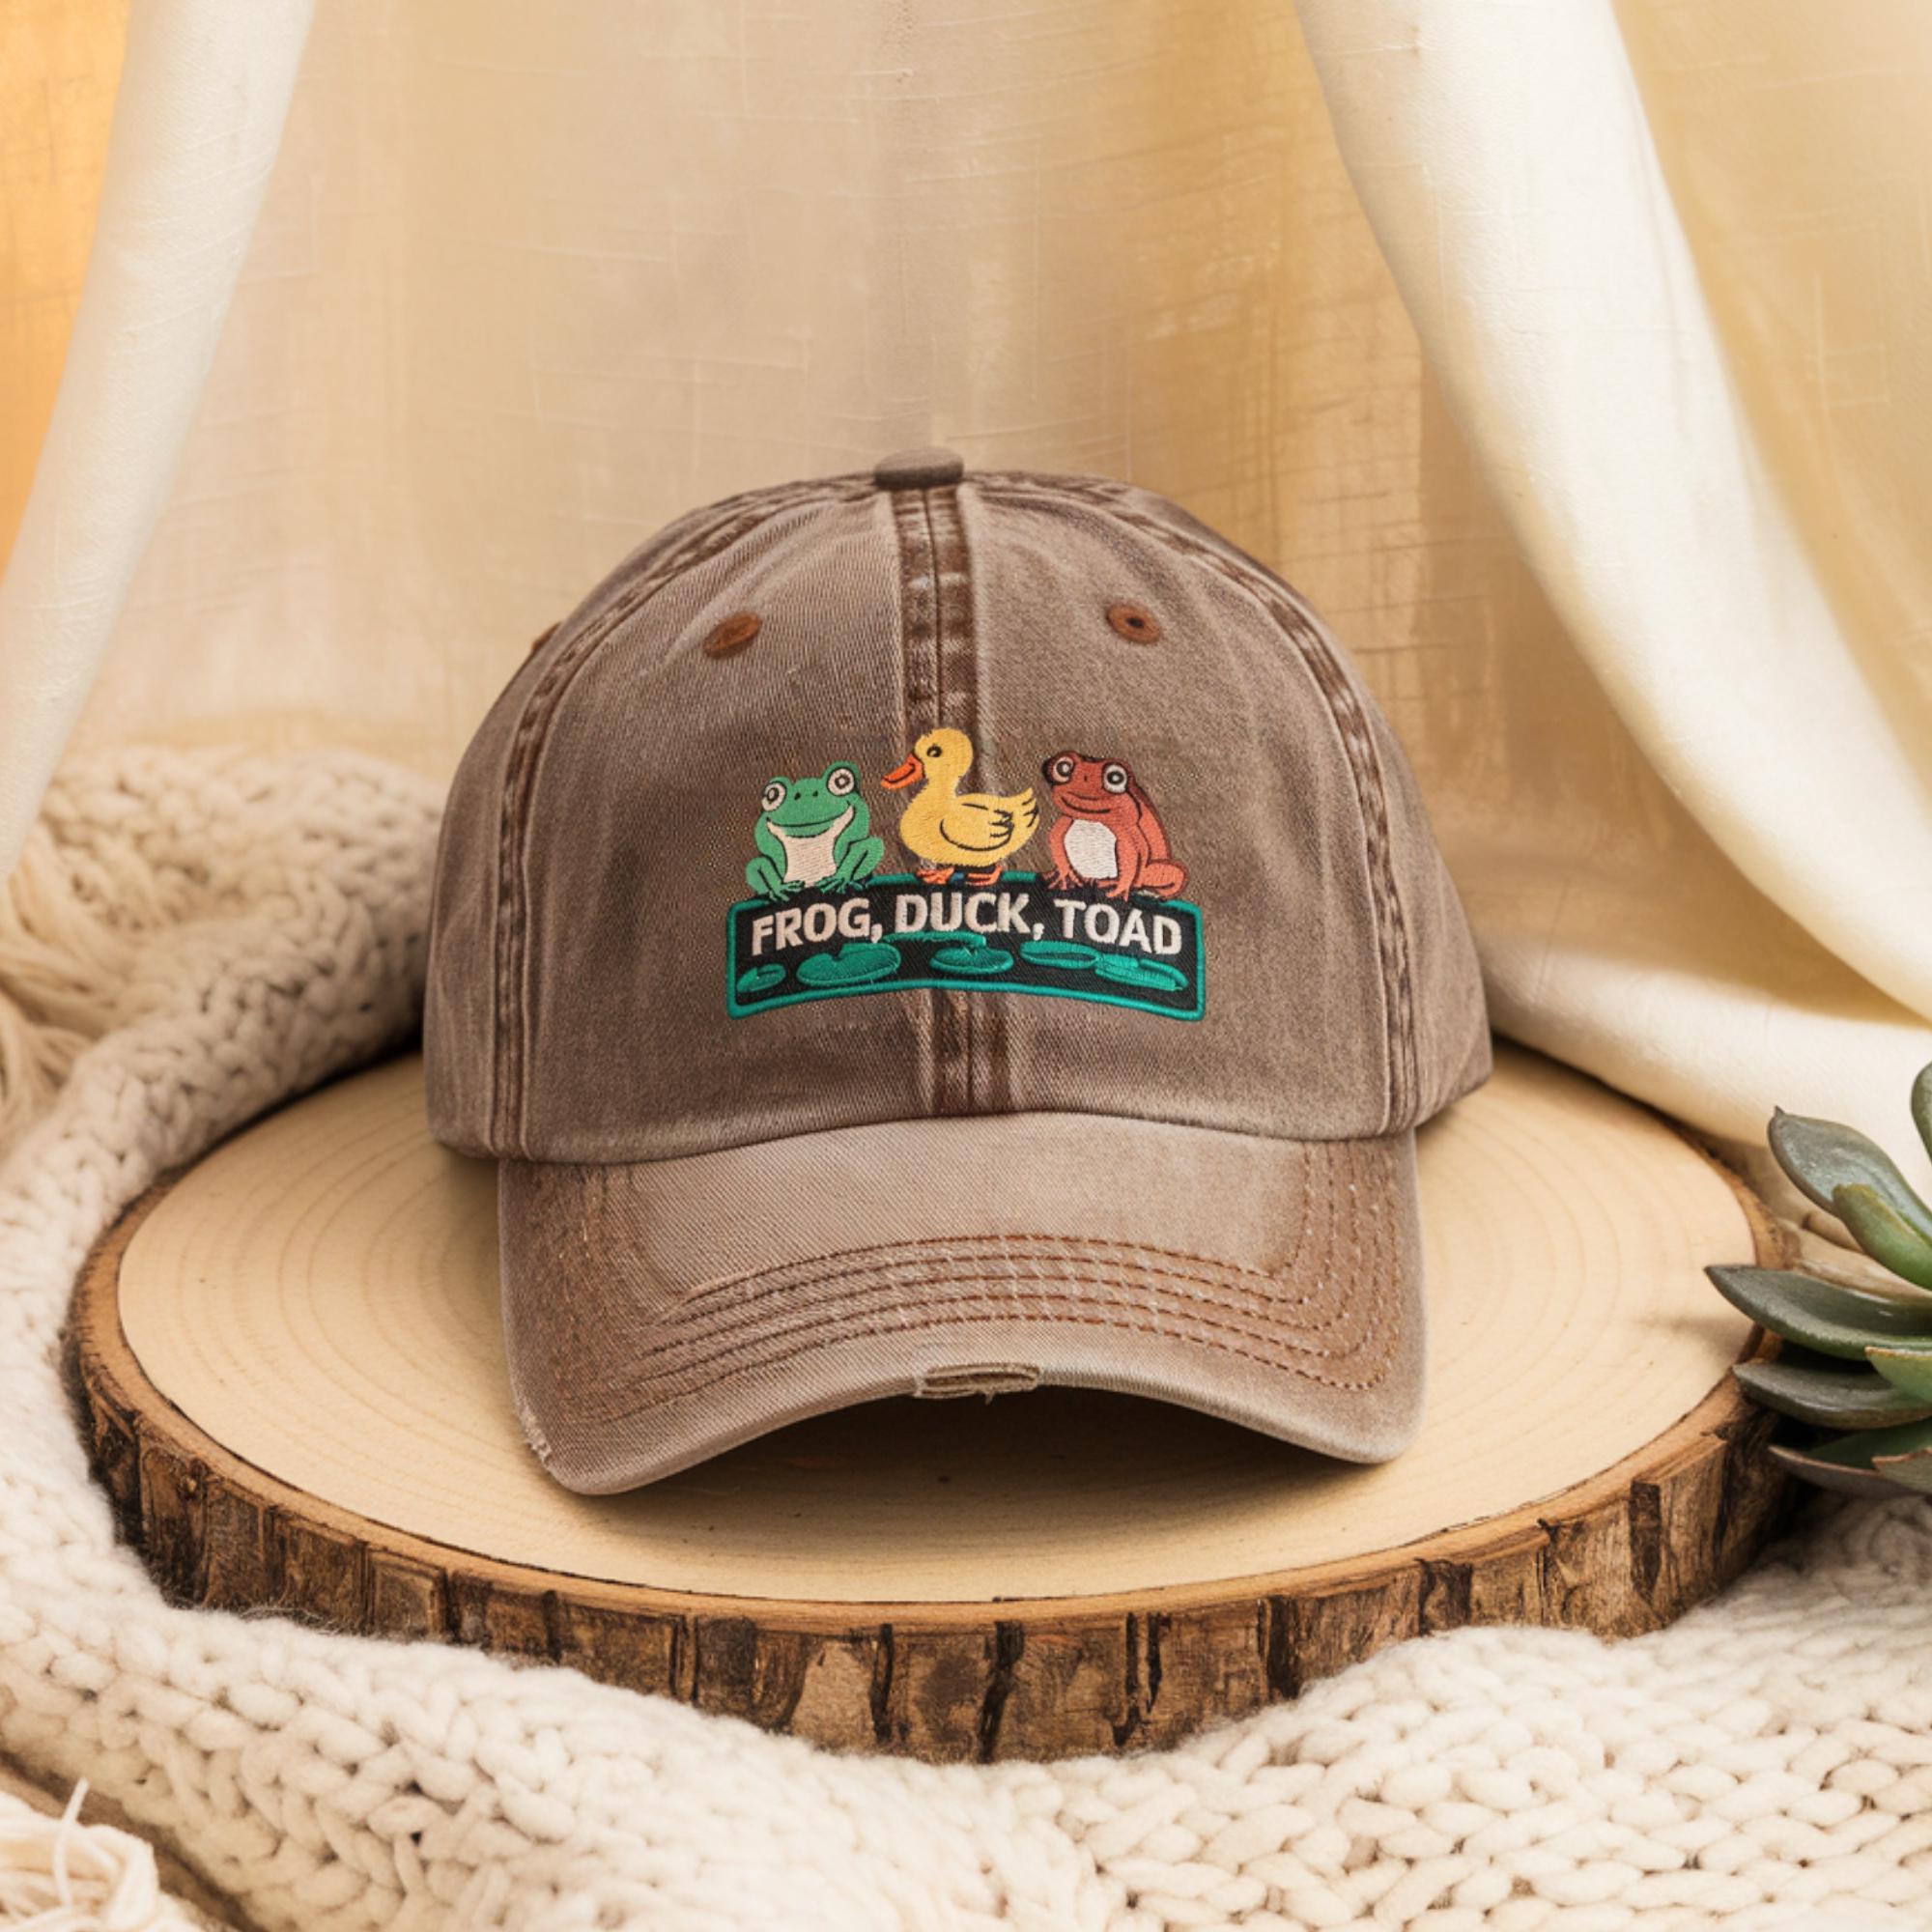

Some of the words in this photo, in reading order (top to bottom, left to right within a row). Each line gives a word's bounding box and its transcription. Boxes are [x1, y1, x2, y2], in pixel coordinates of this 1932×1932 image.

[752, 897, 883, 955] FROG,
[895, 892, 1045, 941] DUCK,
[1053, 899, 1182, 954] TOAD
